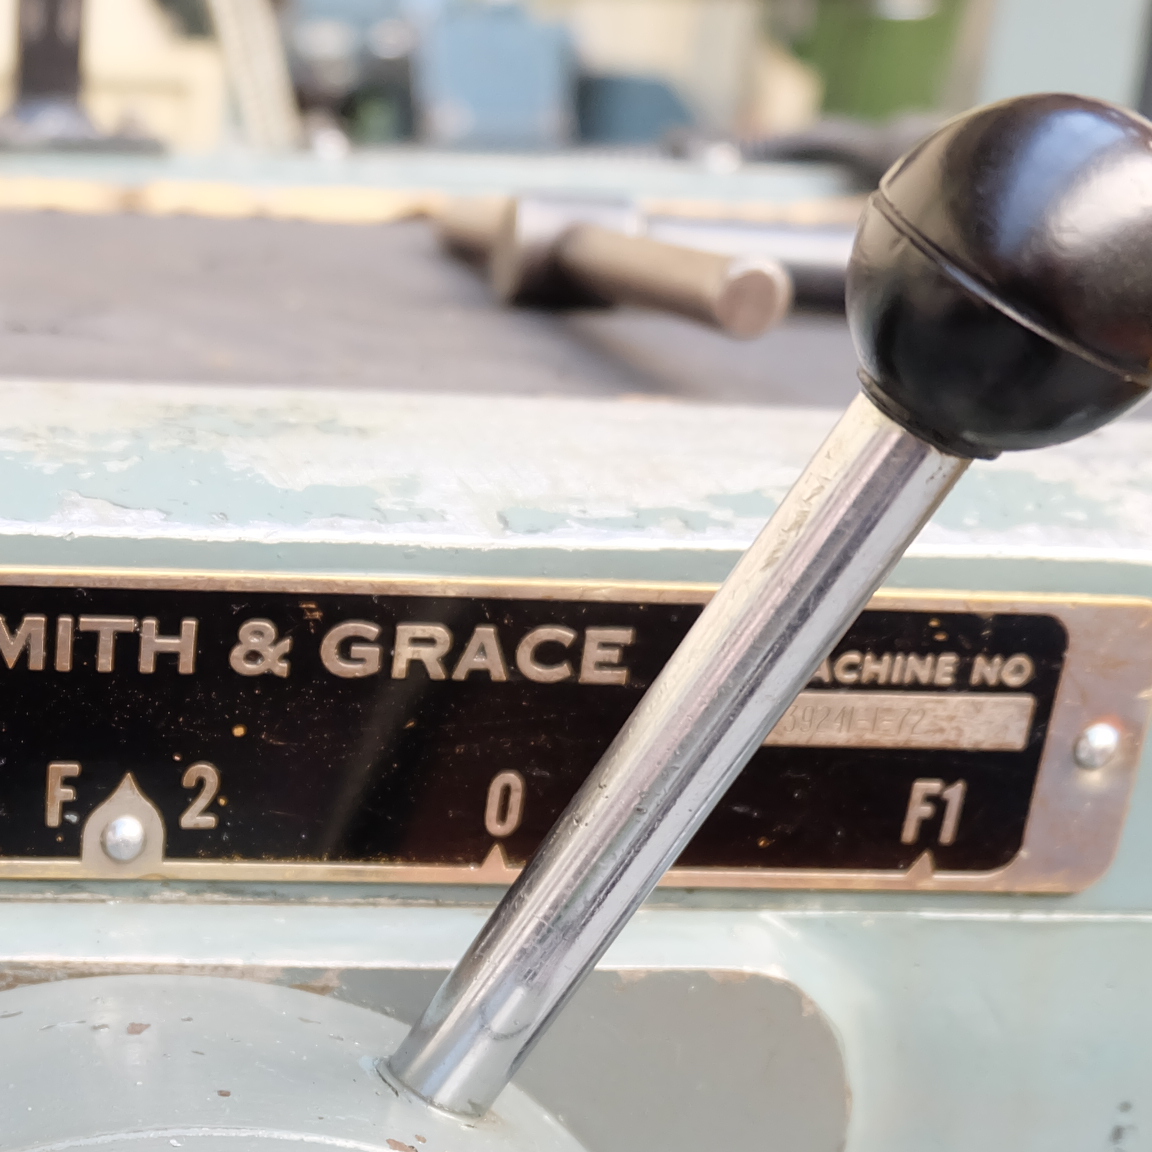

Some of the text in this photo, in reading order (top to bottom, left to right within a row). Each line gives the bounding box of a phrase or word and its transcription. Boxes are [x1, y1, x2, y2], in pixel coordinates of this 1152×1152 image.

[228, 618, 293, 679] &
[320, 620, 634, 685] GRACE
[812, 651, 1035, 688] ACHINE NO
[901, 778, 967, 846] F1
